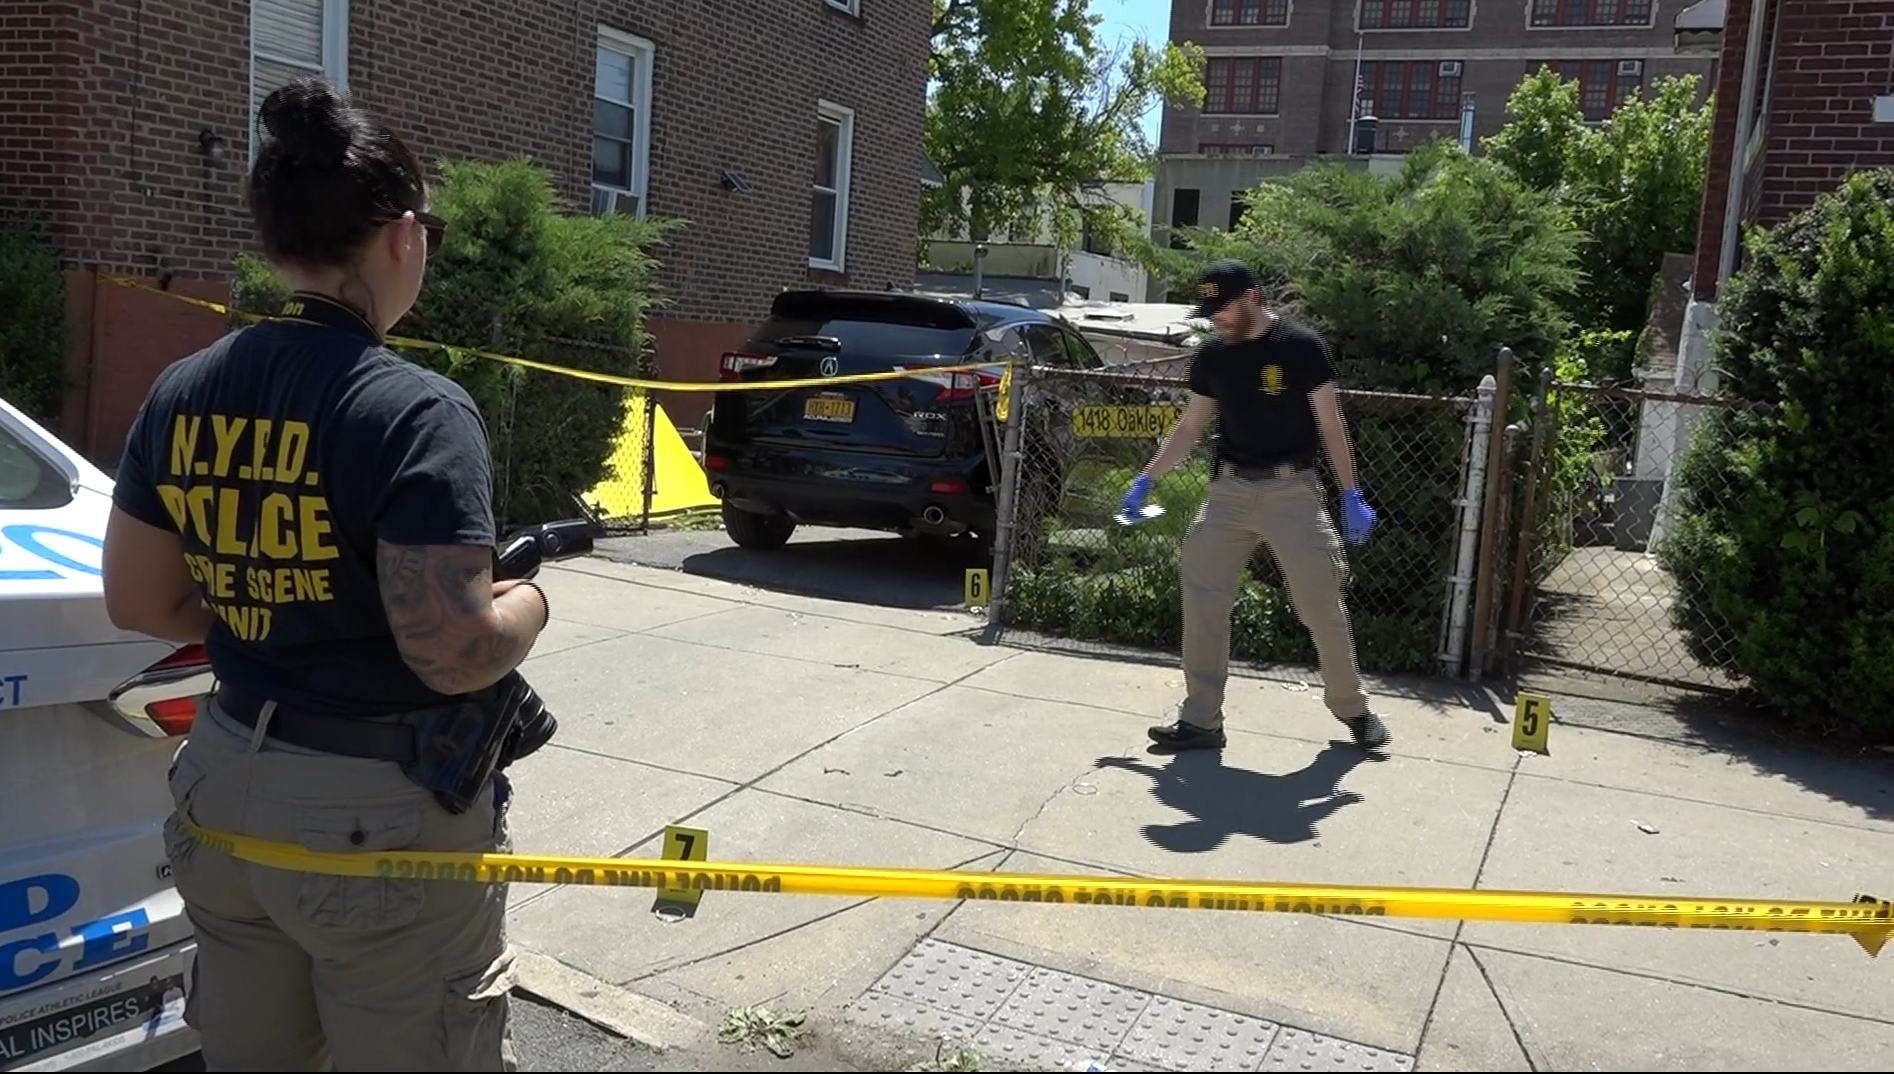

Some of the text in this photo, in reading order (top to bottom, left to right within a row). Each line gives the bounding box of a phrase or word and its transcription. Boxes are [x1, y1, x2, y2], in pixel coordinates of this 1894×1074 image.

[913, 410, 947, 421] RDX
[1080, 408, 1111, 432] 1418
[1117, 407, 1165, 435] Oakley
[183, 551, 334, 604] CRE SCENE
[971, 573, 981, 598] 6
[1521, 699, 1540, 737] 5
[675, 832, 695, 861] 7
[87, 982, 122, 1000] LEAGUE
[30, 996, 141, 1051] INSPIRES
